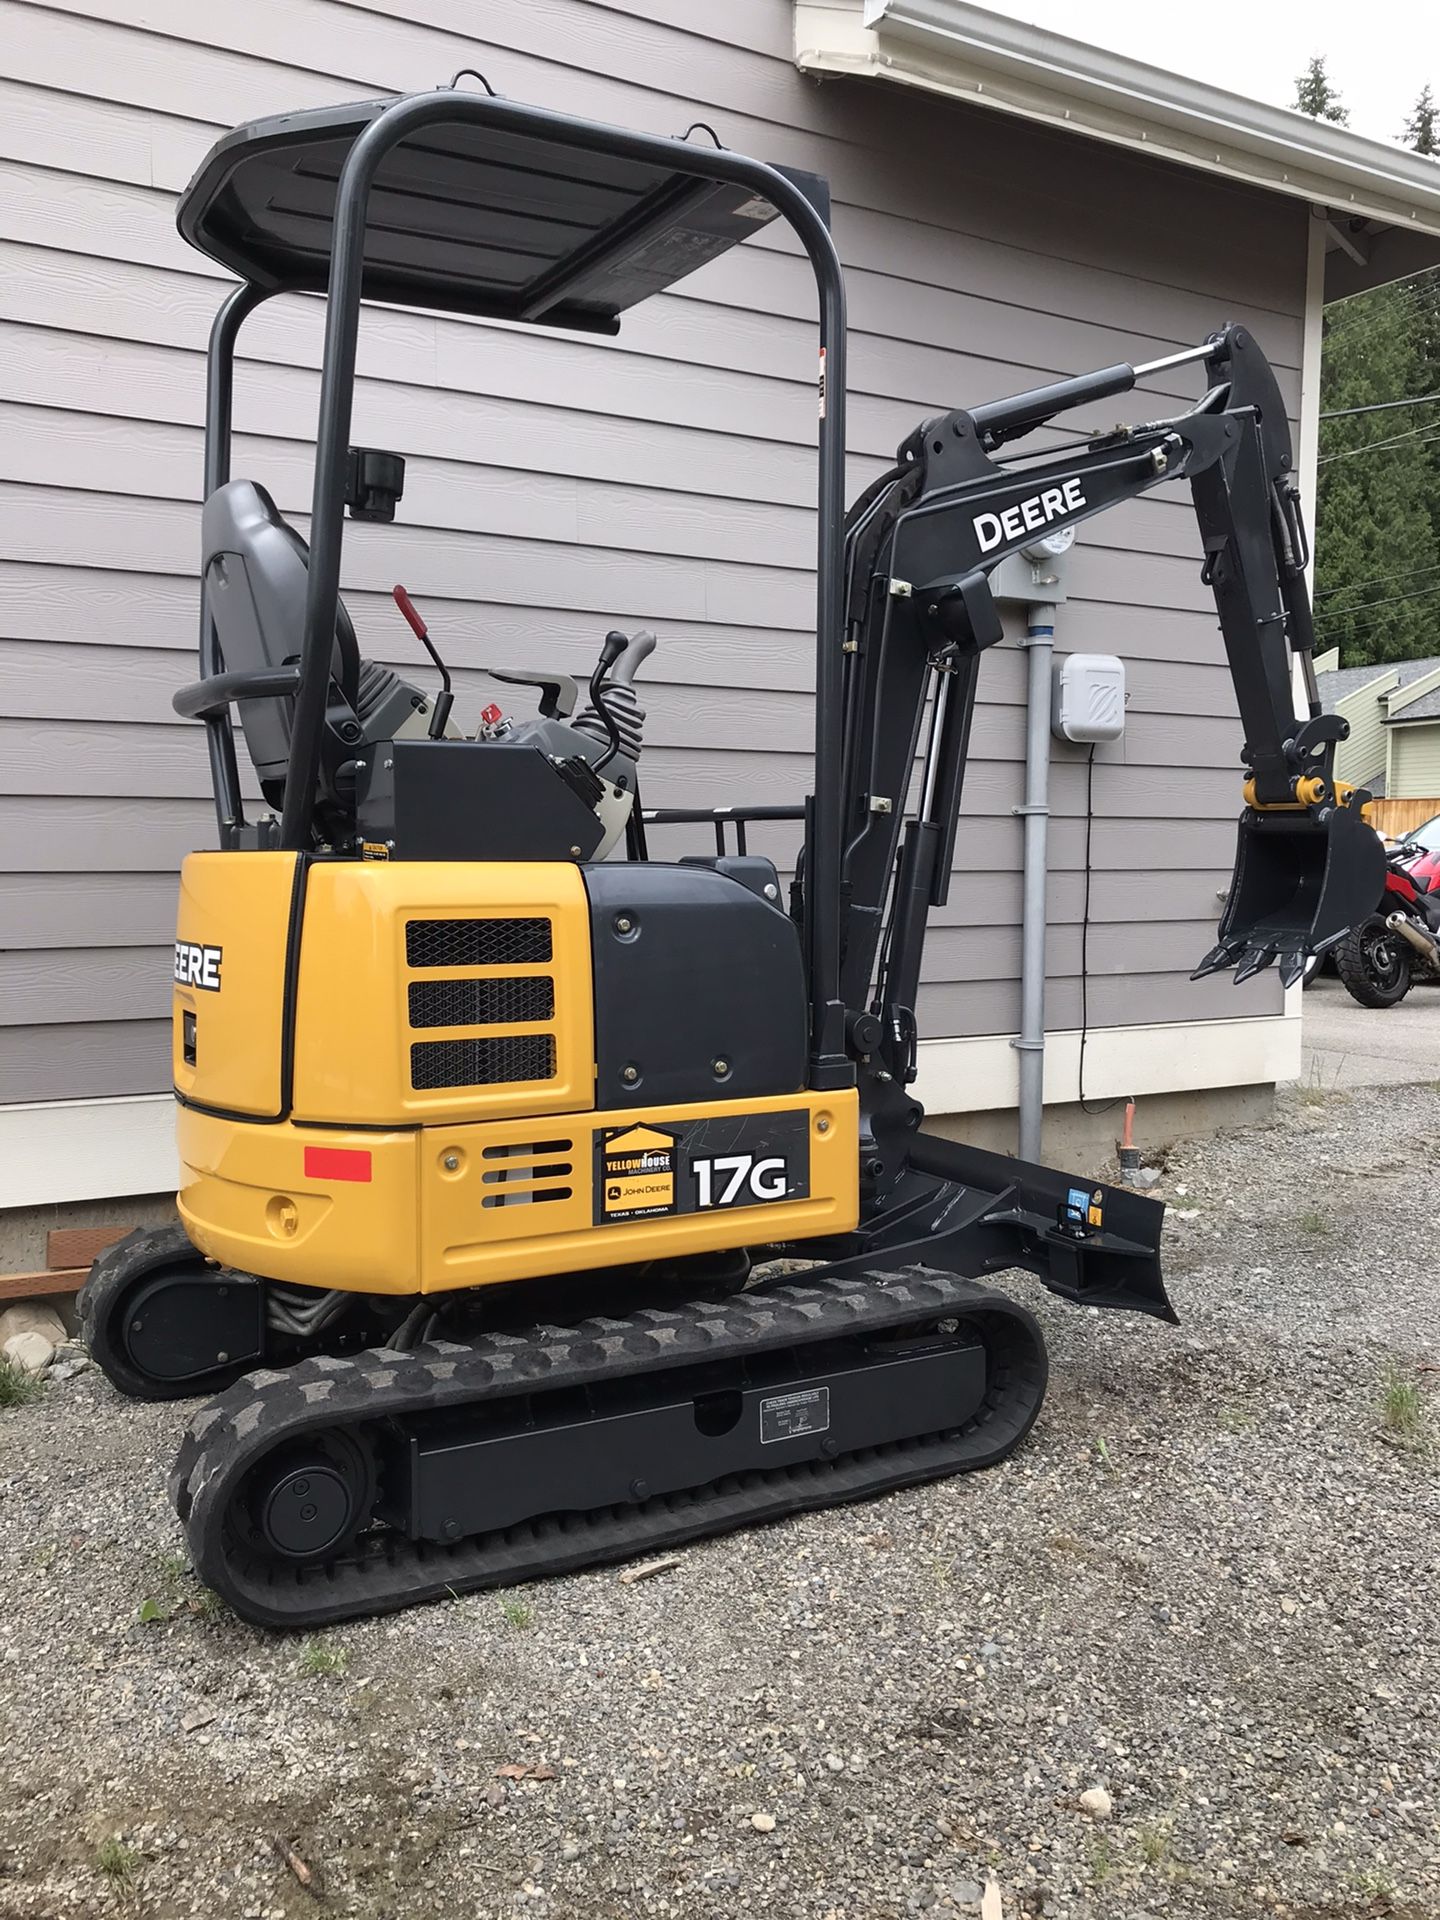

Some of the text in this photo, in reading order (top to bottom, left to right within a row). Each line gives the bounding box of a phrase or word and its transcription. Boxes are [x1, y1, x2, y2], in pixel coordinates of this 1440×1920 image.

[973, 477, 1087, 553] DEERE
[606, 1153, 671, 1172] YELLOWHOUSE
[628, 1167, 661, 1175] MACHINERY
[693, 1155, 787, 1207] 17G
[623, 1184, 671, 1196] JOHN DEERE
[635, 1206, 669, 1215] OKLAHOMA
